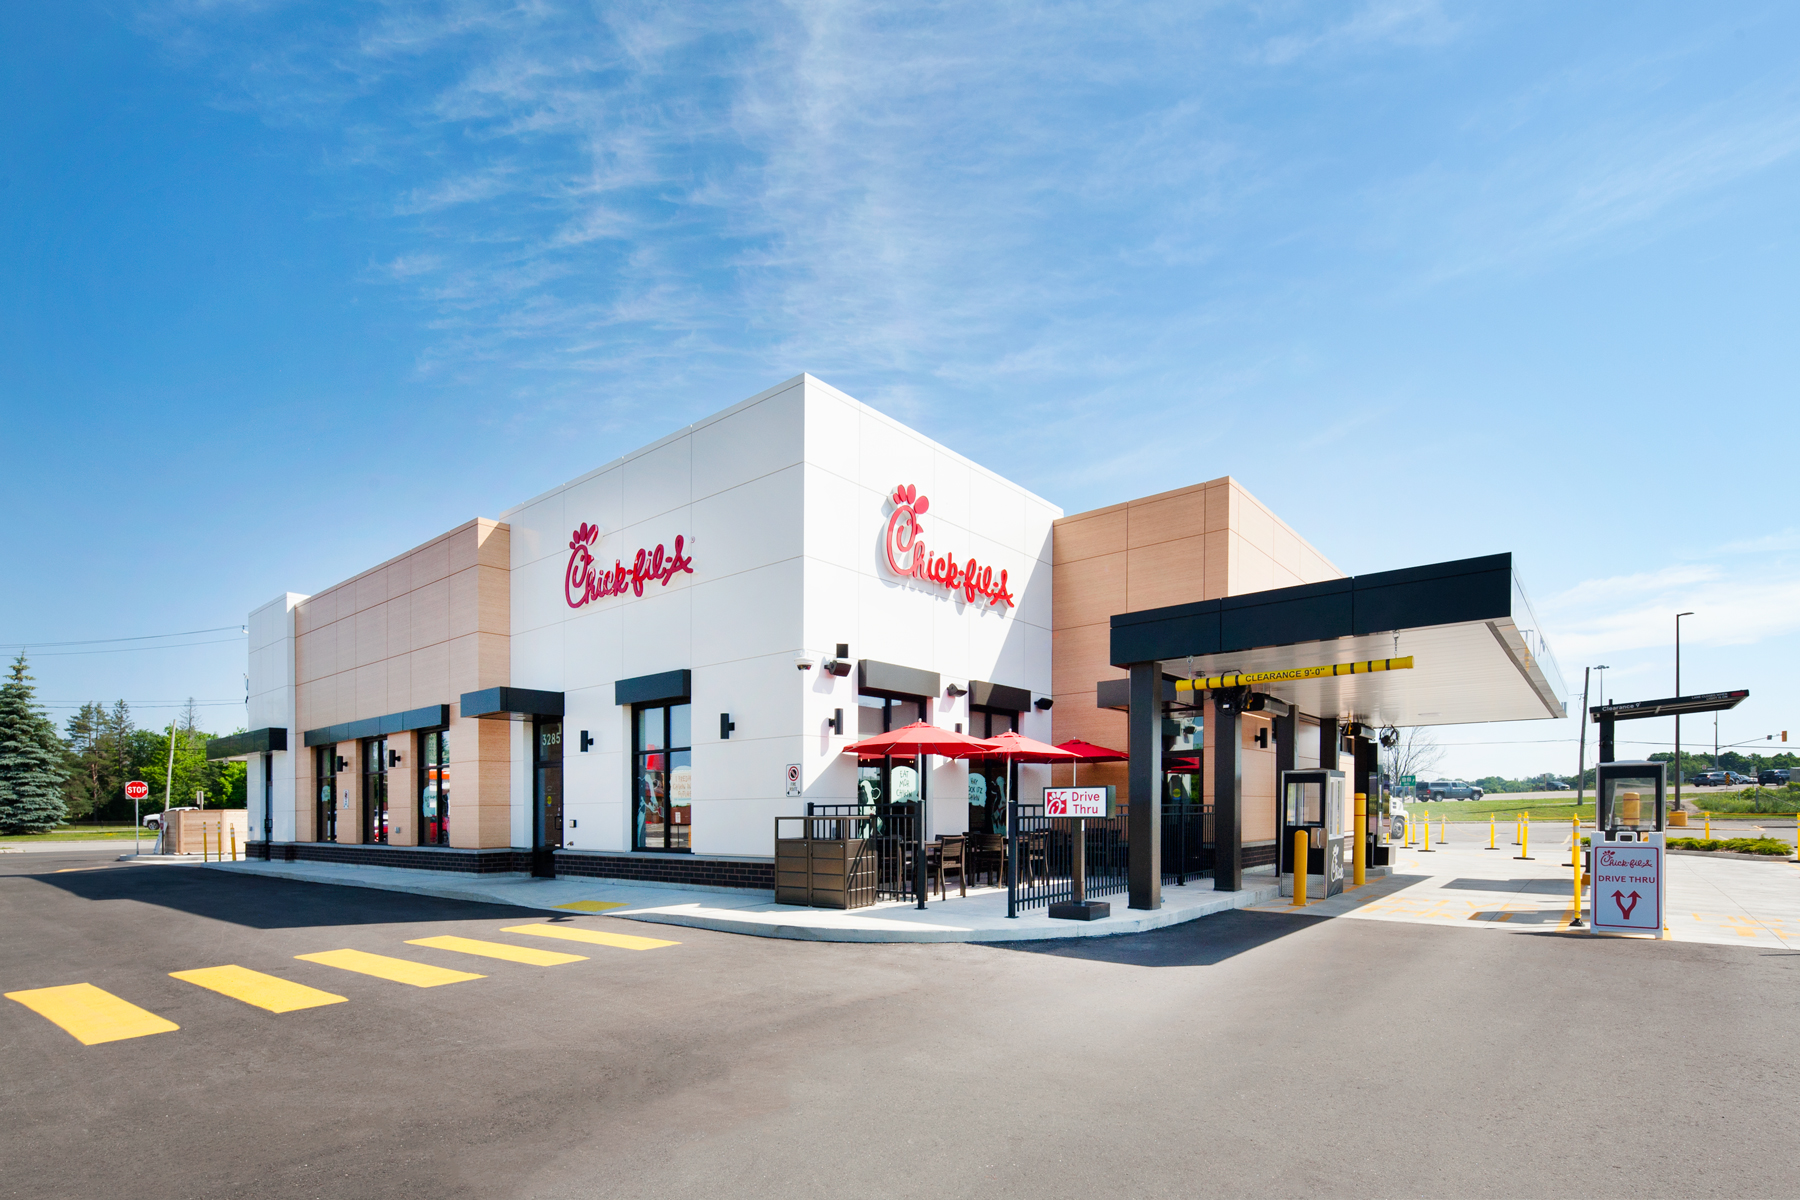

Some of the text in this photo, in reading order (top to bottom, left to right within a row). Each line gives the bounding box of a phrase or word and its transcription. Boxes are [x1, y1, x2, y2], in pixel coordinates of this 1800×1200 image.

[886, 484, 1015, 608] Chick-fil-A
[565, 522, 694, 608] Chick-fil-A
[1245, 670, 1302, 682] CLEARANCE
[1602, 702, 1635, 712] Clearance
[542, 733, 561, 746] 3285
[899, 770, 909, 779] EAT
[127, 786, 147, 794] STOP
[1071, 791, 1100, 801] Drive
[1072, 803, 1098, 814] Thru
[1598, 874, 1655, 884] DRIVE THRU
